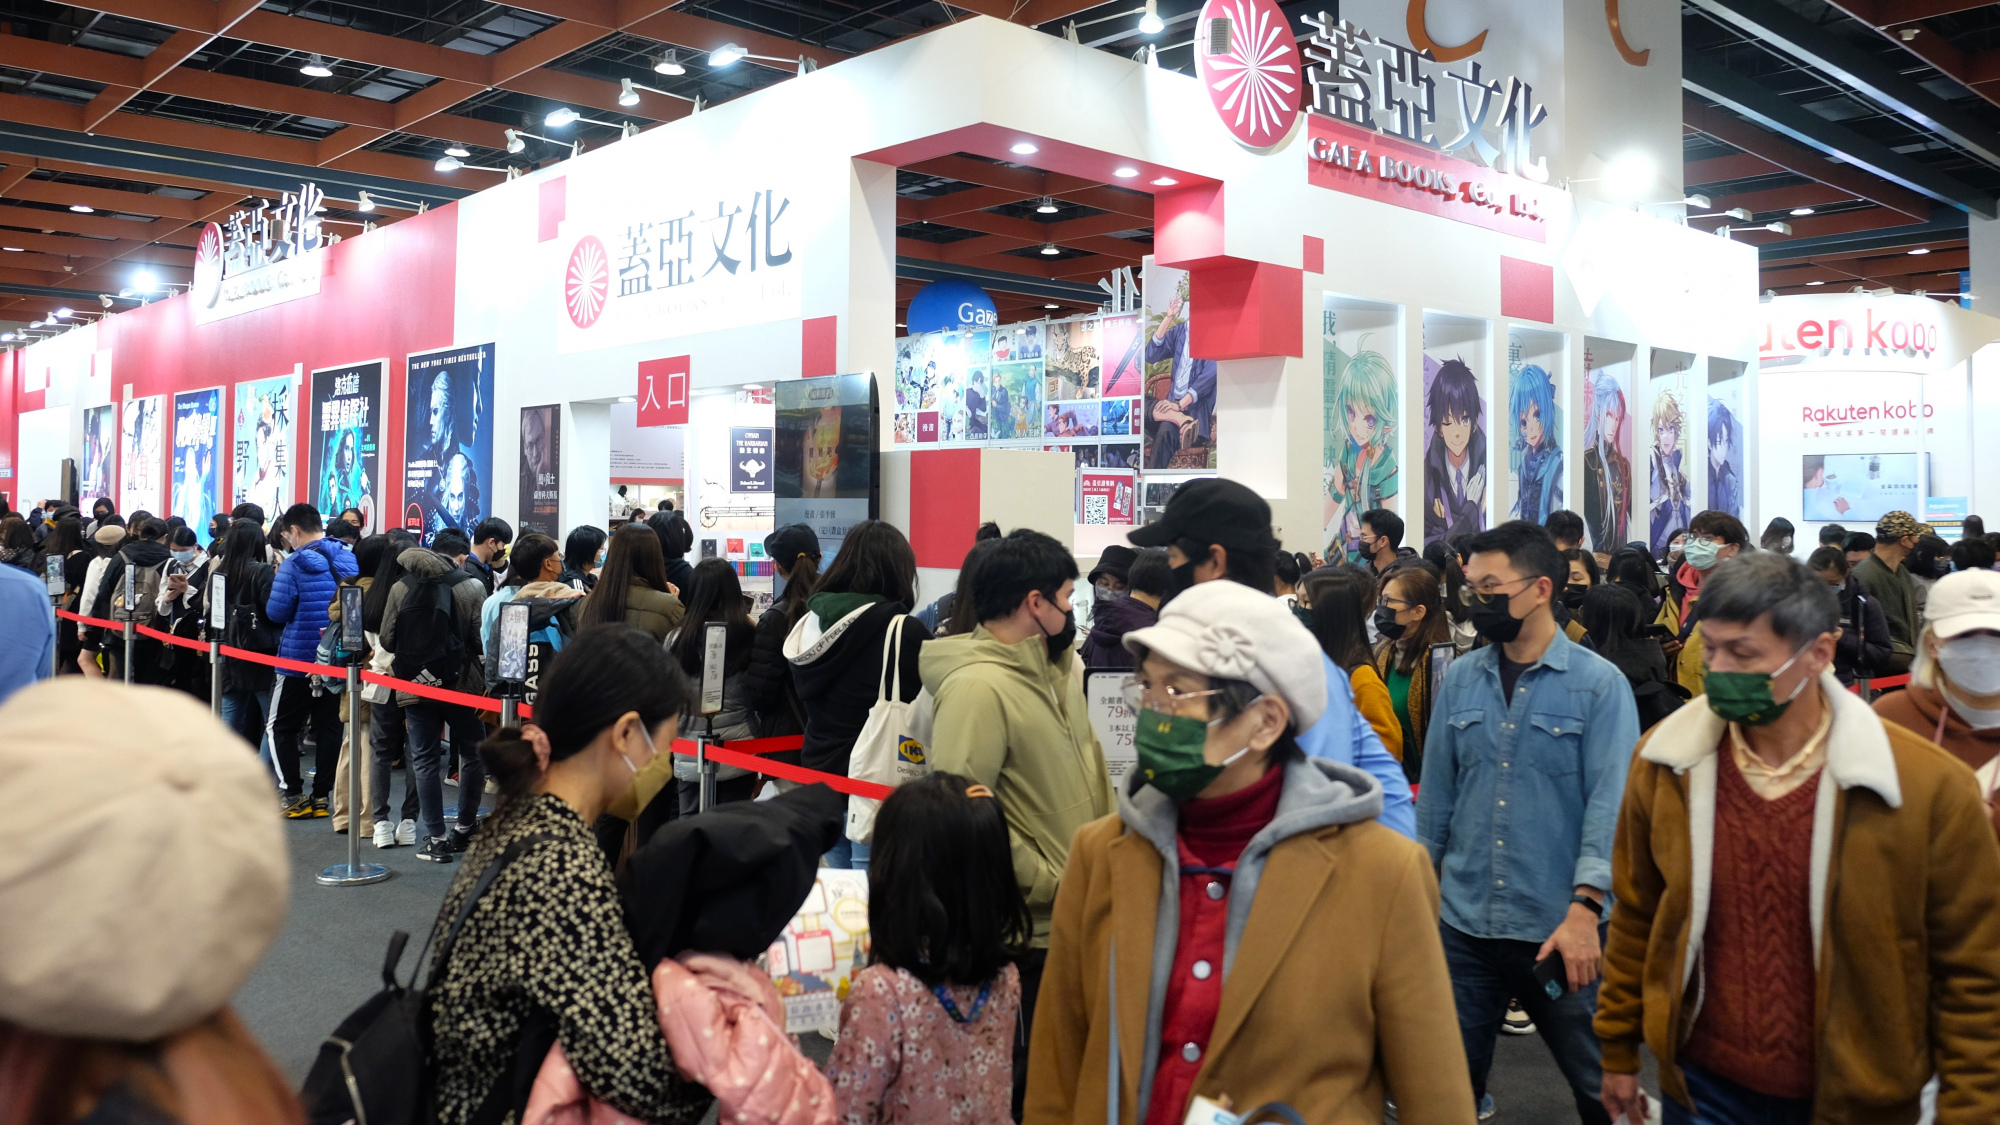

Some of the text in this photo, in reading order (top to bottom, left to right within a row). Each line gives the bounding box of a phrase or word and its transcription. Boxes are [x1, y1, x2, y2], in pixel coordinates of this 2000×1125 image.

[1301, 10, 1549, 183] 蓋亞文化
[1308, 137, 1373, 173] GAEA
[223, 183, 324, 278] 蓋亞文化
[617, 189, 793, 298] 蓋亞文化
[431, 358, 442, 367] YORK
[443, 355, 457, 366] TIMES
[640, 372, 686, 412] 入口
[1802, 404, 1880, 423] Rakuten
[1100, 696, 1127, 705] 全館書
[1116, 734, 1137, 746] 75
